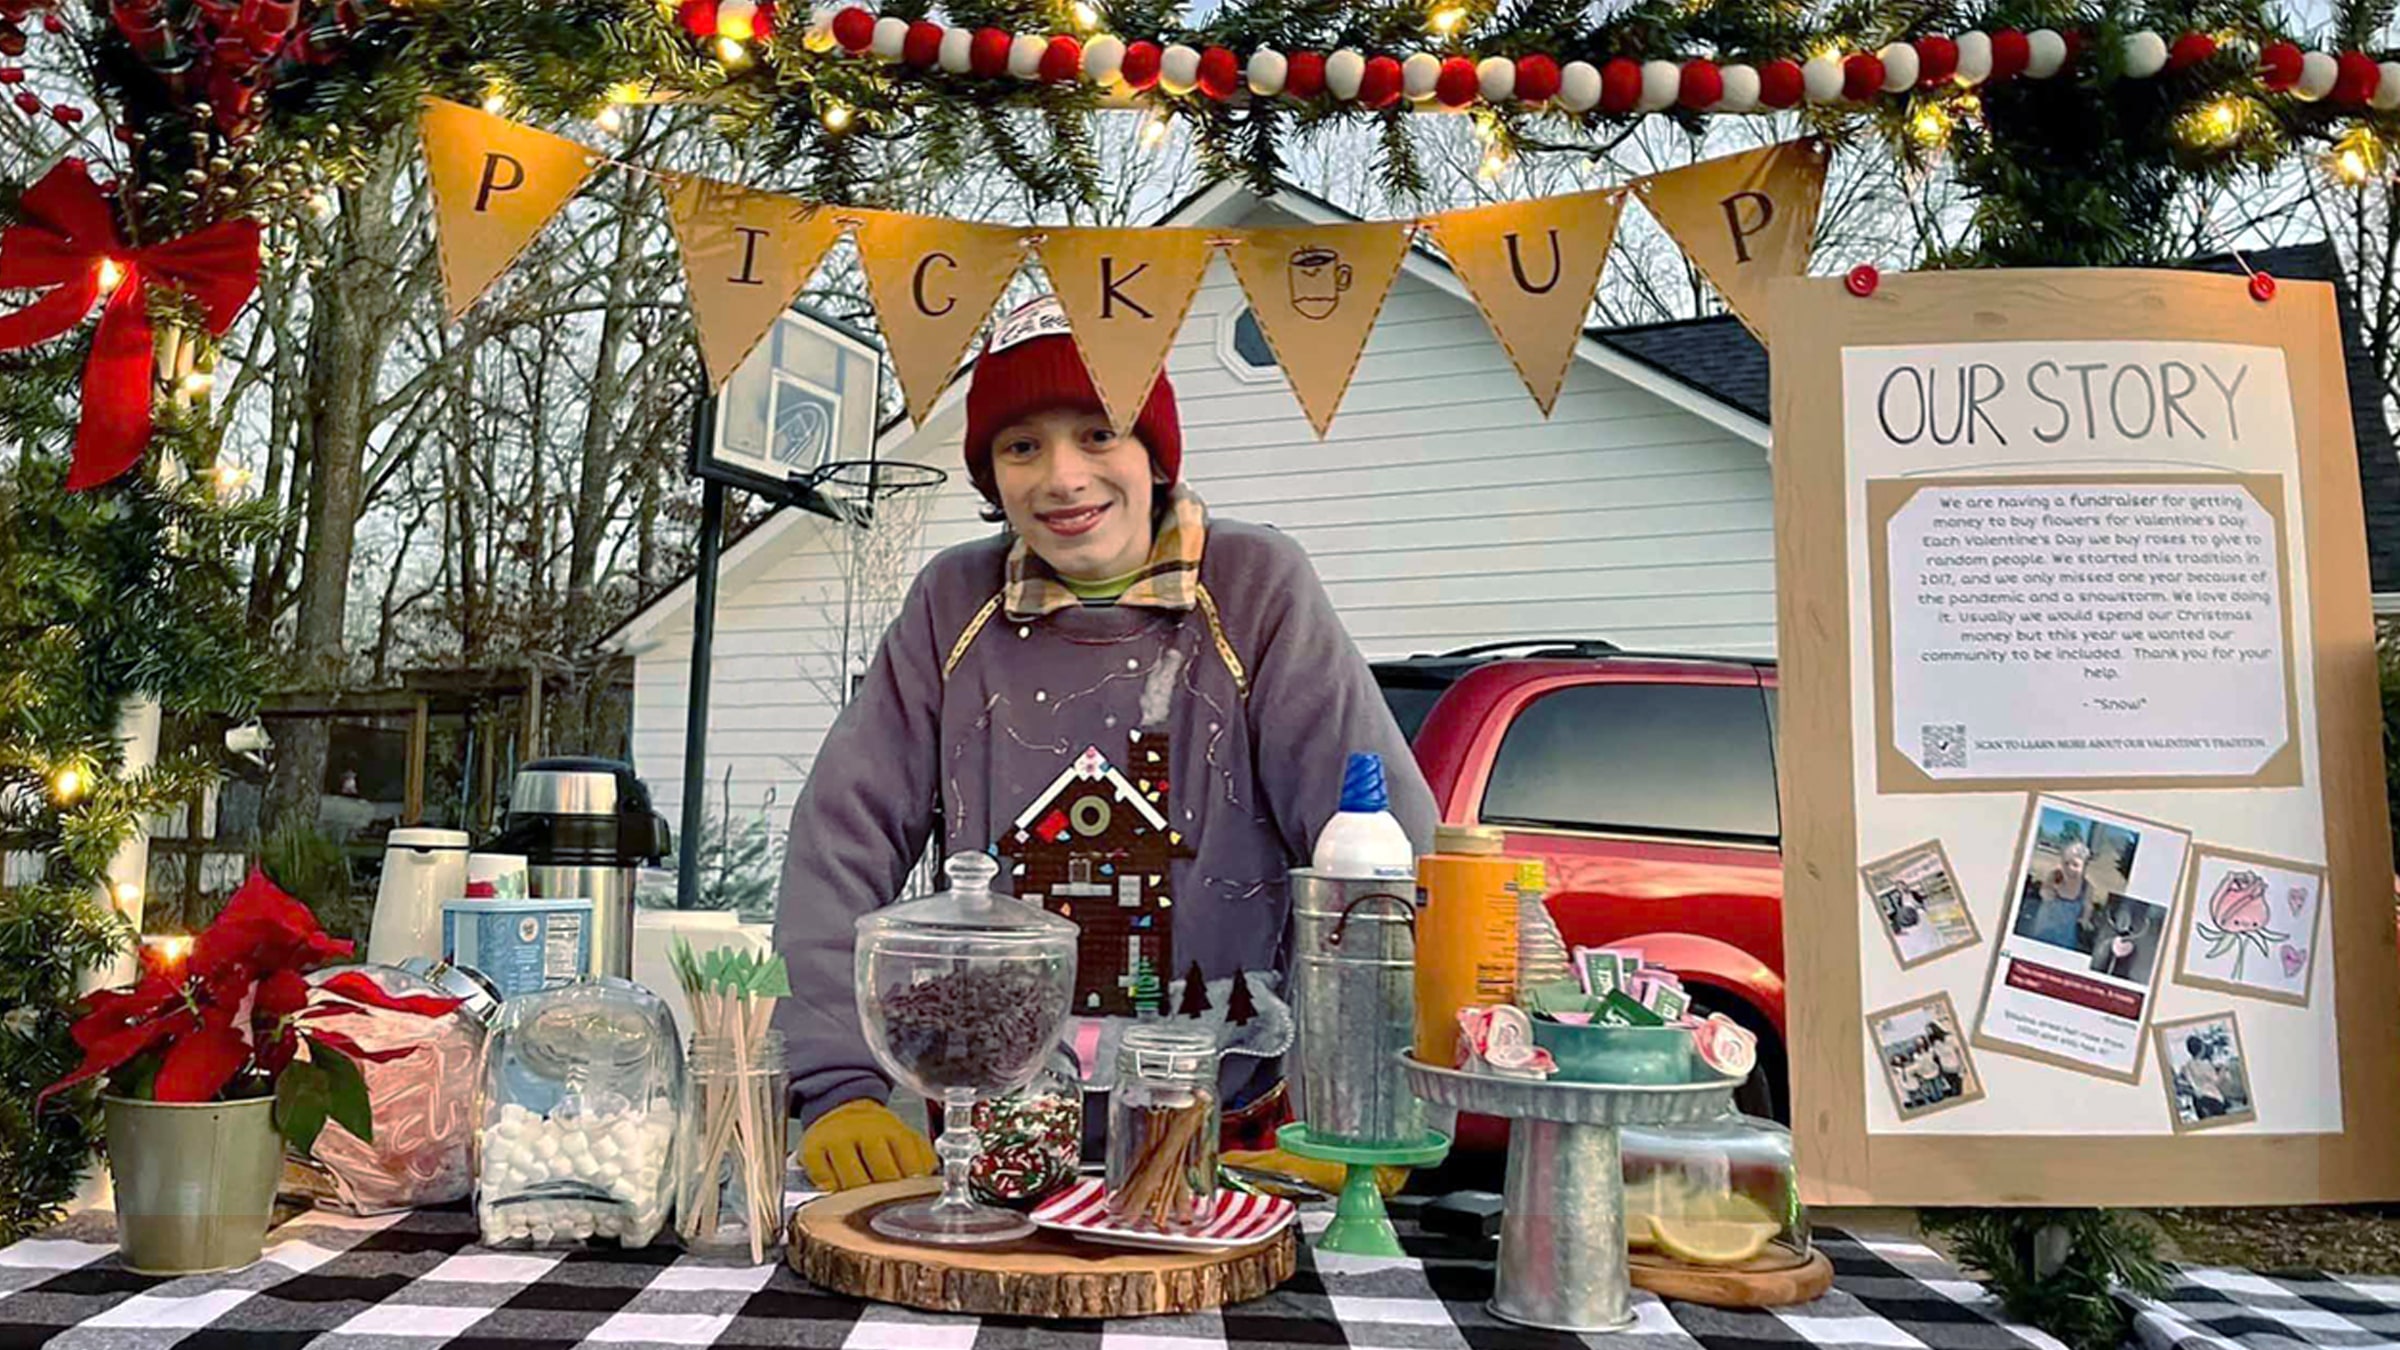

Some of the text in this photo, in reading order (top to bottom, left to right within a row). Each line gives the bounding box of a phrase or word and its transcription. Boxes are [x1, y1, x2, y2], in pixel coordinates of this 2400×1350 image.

[1878, 360, 2249, 445] OUR STORY
[1940, 493, 2243, 510] We are having a fundraiser for getting
[1933, 517, 1984, 529] money
[1989, 516, 2006, 527] to
[2010, 515, 2037, 529] buy
[2042, 514, 2100, 527] flowers
[2105, 513, 2129, 526] for
[2134, 513, 2215, 527] Valentine's
[1922, 533, 2262, 548] Each Valentine's Day we buy roses to give to
[1926, 554, 1988, 566] random
[2053, 554, 2073, 564] We
[2078, 552, 2138, 564] started
[2142, 551, 2171, 564] this
[2175, 551, 2242, 564] tradition
[2246, 552, 2260, 564] in
[1960, 574, 1991, 585] and
[1995, 575, 2018, 584] we
[2022, 572, 2056, 586] only
[2059, 571, 2114, 584] missed
[2118, 572, 2145, 583] one
[2149, 572, 2184, 585] year
[2187, 571, 2247, 583] because
[2251, 571, 2267, 583] of
[1918, 593, 1944, 605] the
[1950, 592, 2025, 607] pandemic
[2029, 592, 2059, 603] and
[2063, 593, 2074, 602] a
[2172, 591, 2193, 602] We
[2196, 591, 2228, 602] love
[2231, 591, 2271, 605] doing
[1959, 610, 2016, 625] Usually
[2020, 612, 2042, 622] we
[2047, 610, 2092, 622] would
[2097, 610, 2143, 623] spend
[2147, 611, 2173, 621] our
[2176, 609, 2252, 621] Christmas
[1960, 628, 2234, 644] money but this year we wanted our
[1921, 650, 2007, 663] community
[2012, 649, 2029, 661] to
[2033, 648, 2052, 661] be
[2133, 647, 2181, 660] Thank
[2182, 650, 2208, 662] you
[2212, 648, 2237, 660] for
[2237, 649, 2272, 662] your
[2005, 740, 2020, 750] TO
[2089, 739, 2122, 749] ABOUT
